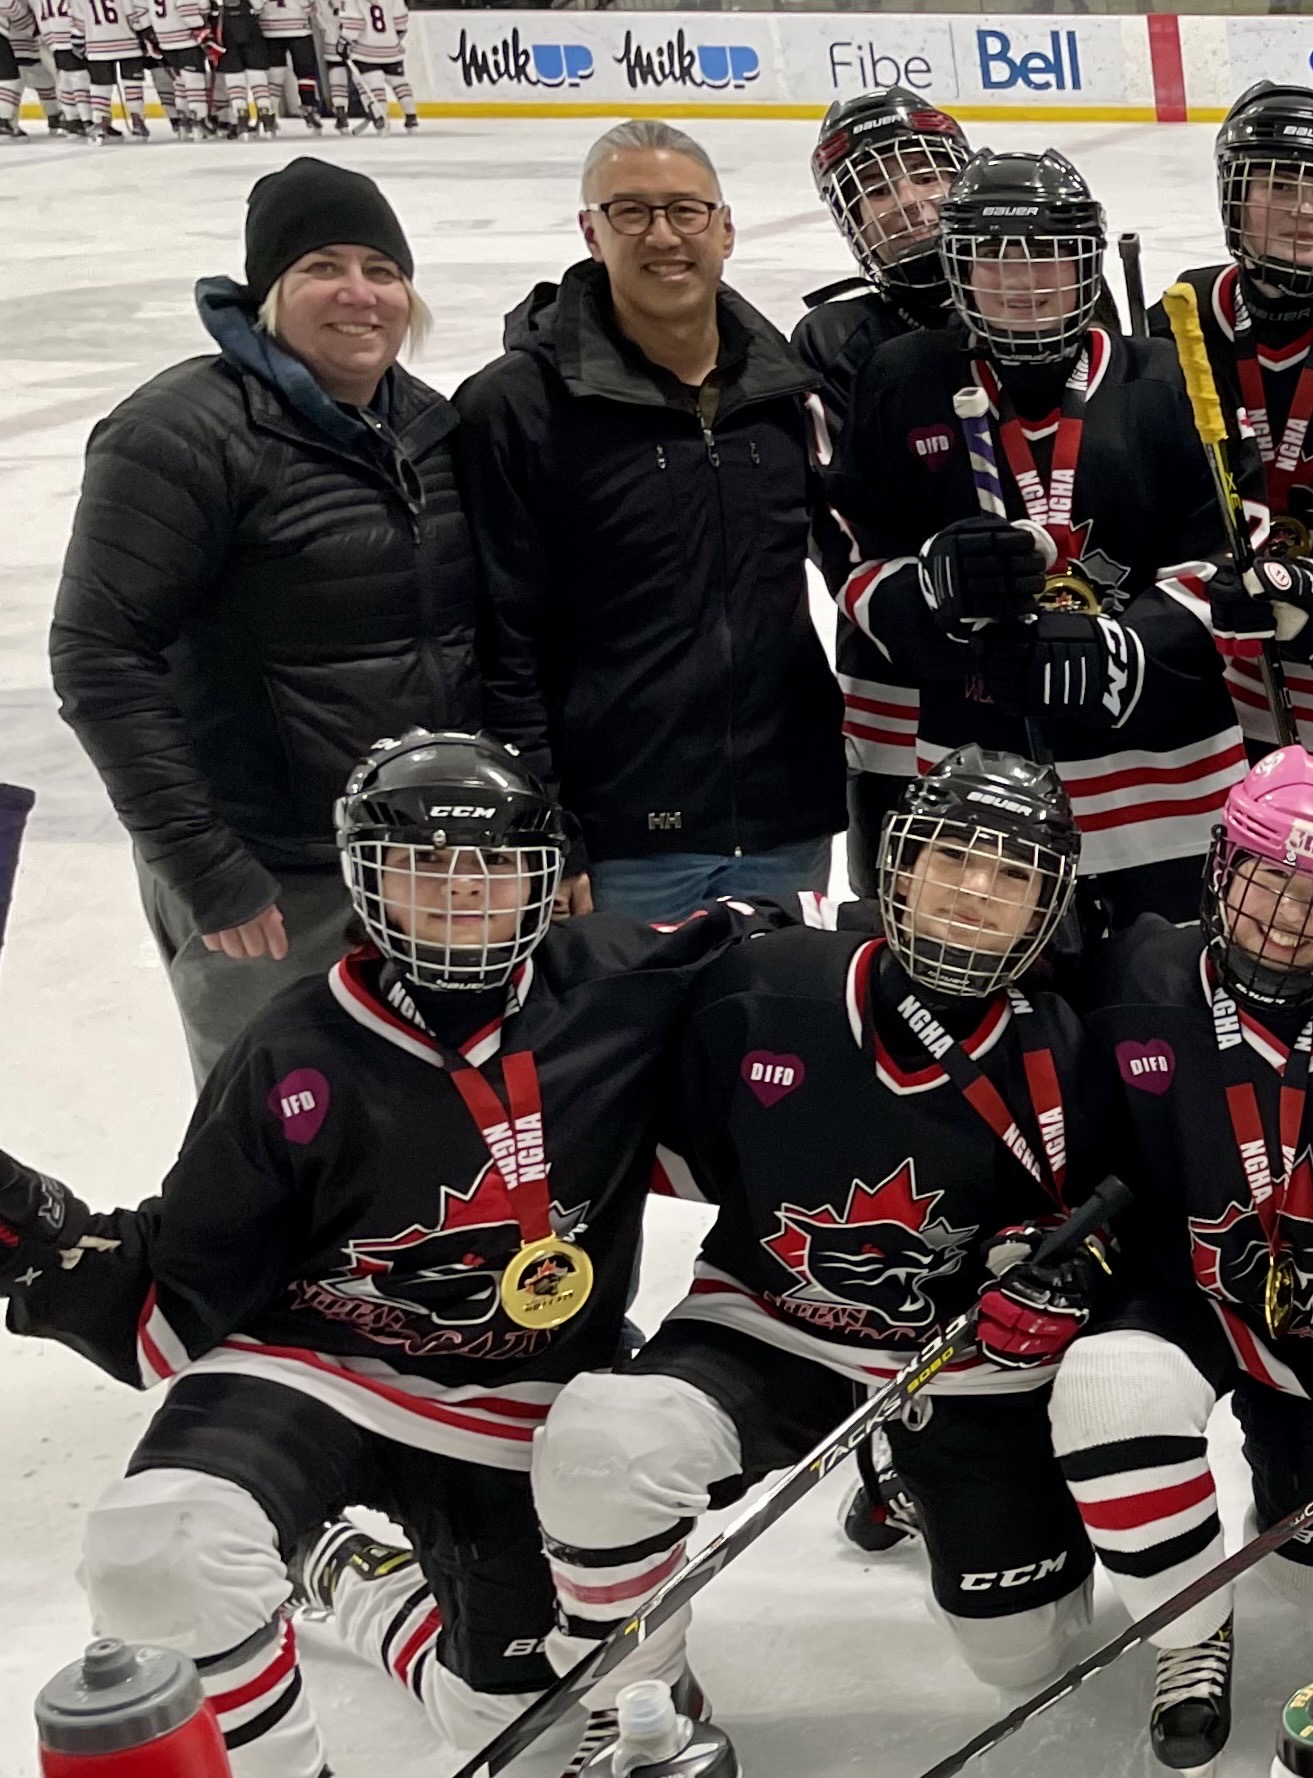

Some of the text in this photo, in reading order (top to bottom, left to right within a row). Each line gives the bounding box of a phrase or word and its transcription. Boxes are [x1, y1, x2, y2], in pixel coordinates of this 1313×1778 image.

[370, 5, 386, 23] 8
[829, 41, 933, 90] Fibe
[978, 30, 1082, 92] Bell
[852, 113, 903, 136] BAUER
[982, 205, 1040, 218] BAUER
[915, 435, 950, 456] DIFD
[1247, 408, 1277, 462] NGHA
[1275, 418, 1309, 472] NGHA
[1048, 468, 1076, 525] NGHA
[429, 806, 497, 821] CCM
[648, 811, 682, 830] HH
[966, 790, 1034, 818] BAUER
[896, 994, 956, 1061] NGHA
[750, 1062, 795, 1087] DIFD
[1129, 1055, 1169, 1077] DIFD
[281, 1090, 316, 1119] IFD
[515, 1111, 546, 1183] NGHA
[1002, 1122, 1042, 1184] NGHA
[1038, 1106, 1067, 1172] NGHA
[1240, 1139, 1274, 1204] NGHA
[810, 1390, 901, 1480] TACKS
[959, 1551, 1068, 1592] CCM
